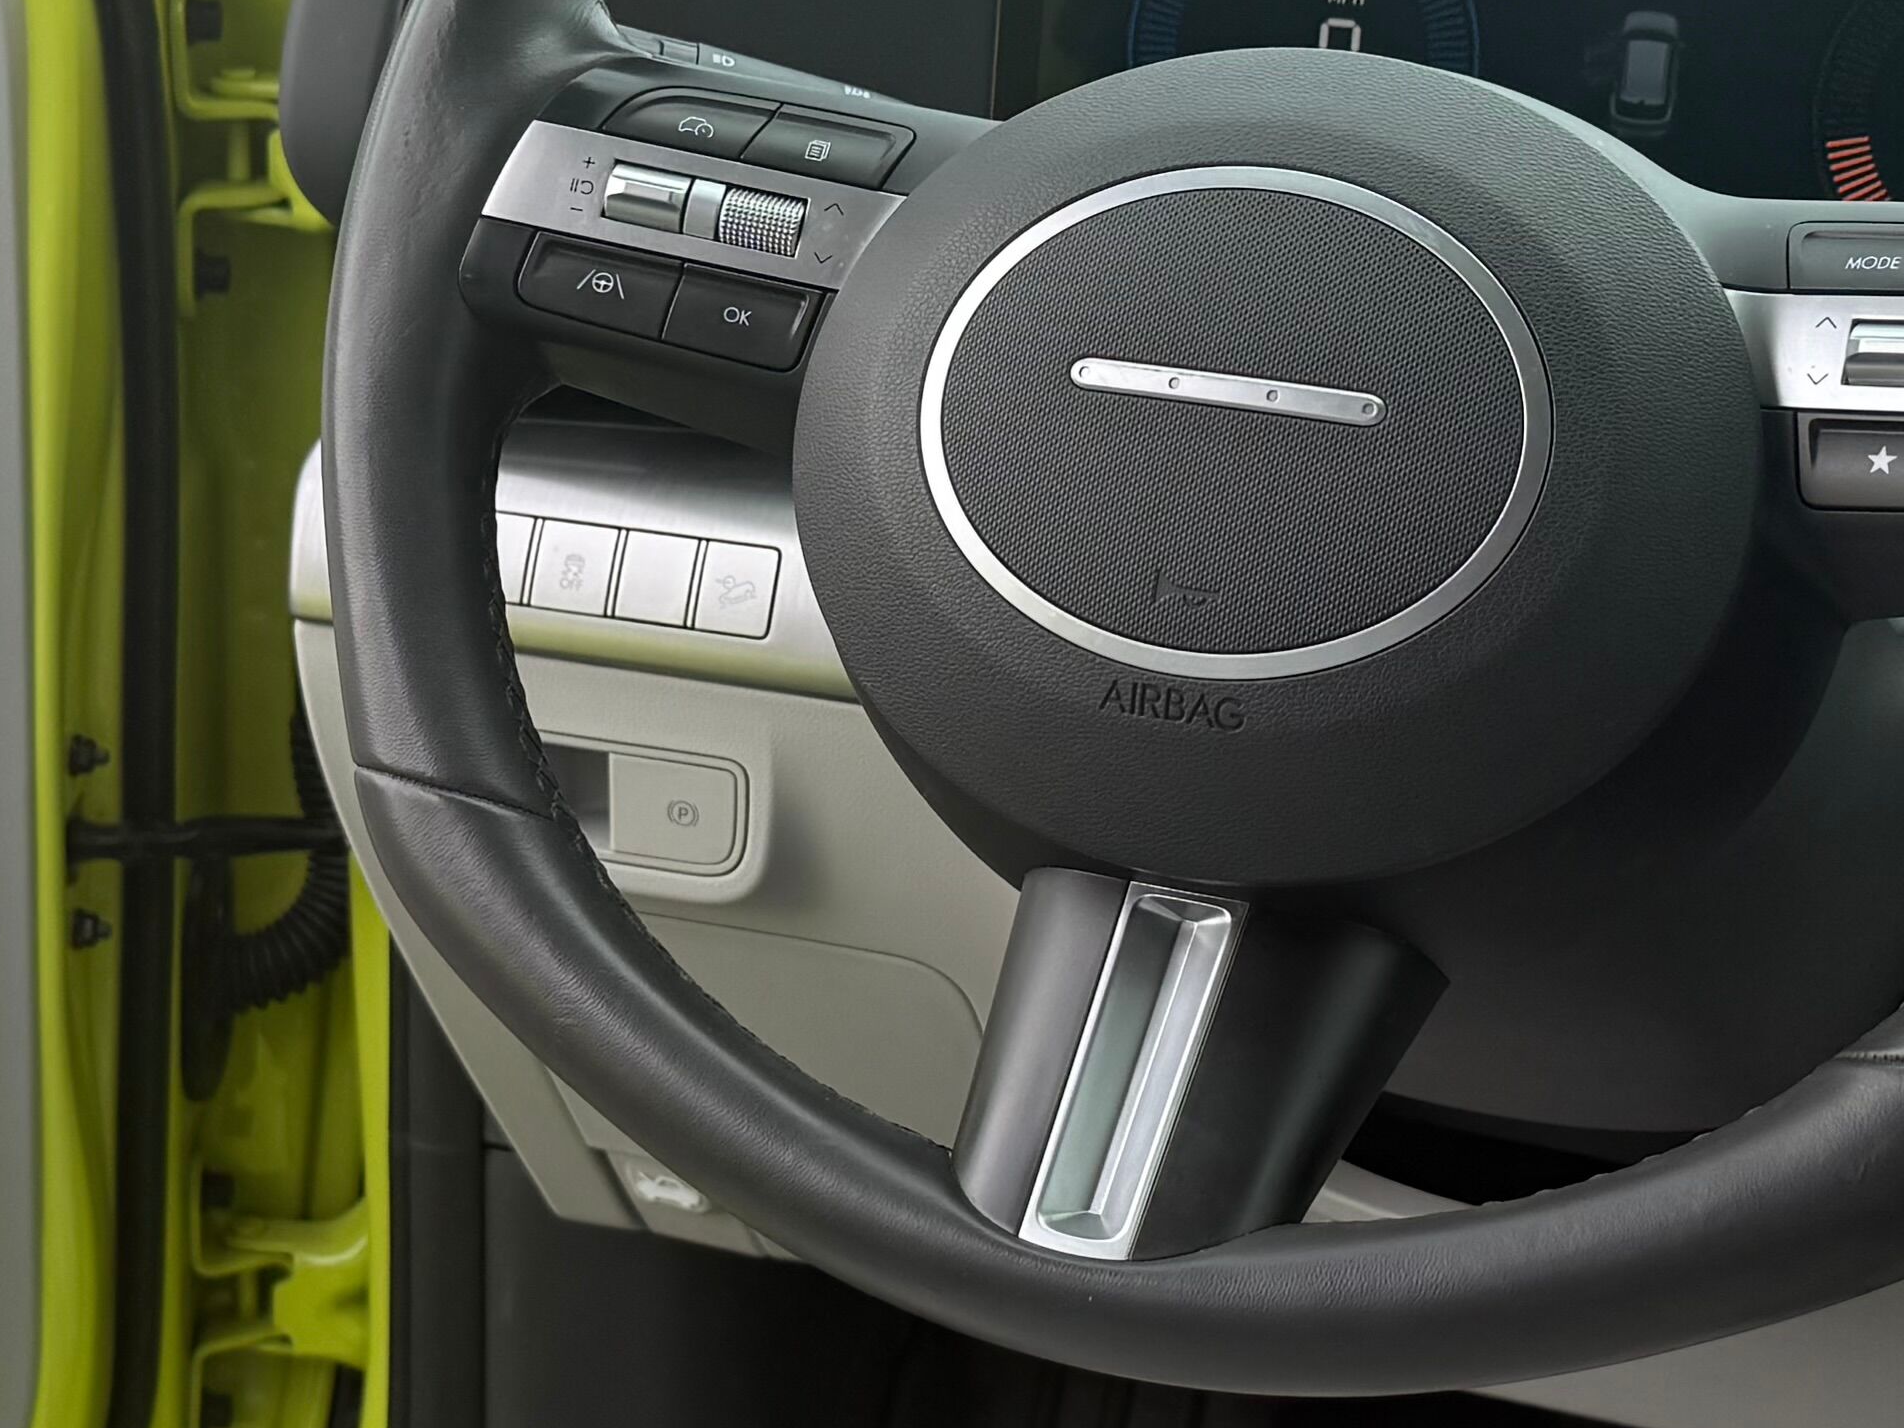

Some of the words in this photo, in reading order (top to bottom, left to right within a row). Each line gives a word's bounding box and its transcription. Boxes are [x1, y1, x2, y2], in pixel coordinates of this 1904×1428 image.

[1845, 255, 1902, 270] MODE
[723, 307, 751, 327] OK
[1099, 679, 1247, 734] AIRBAG
